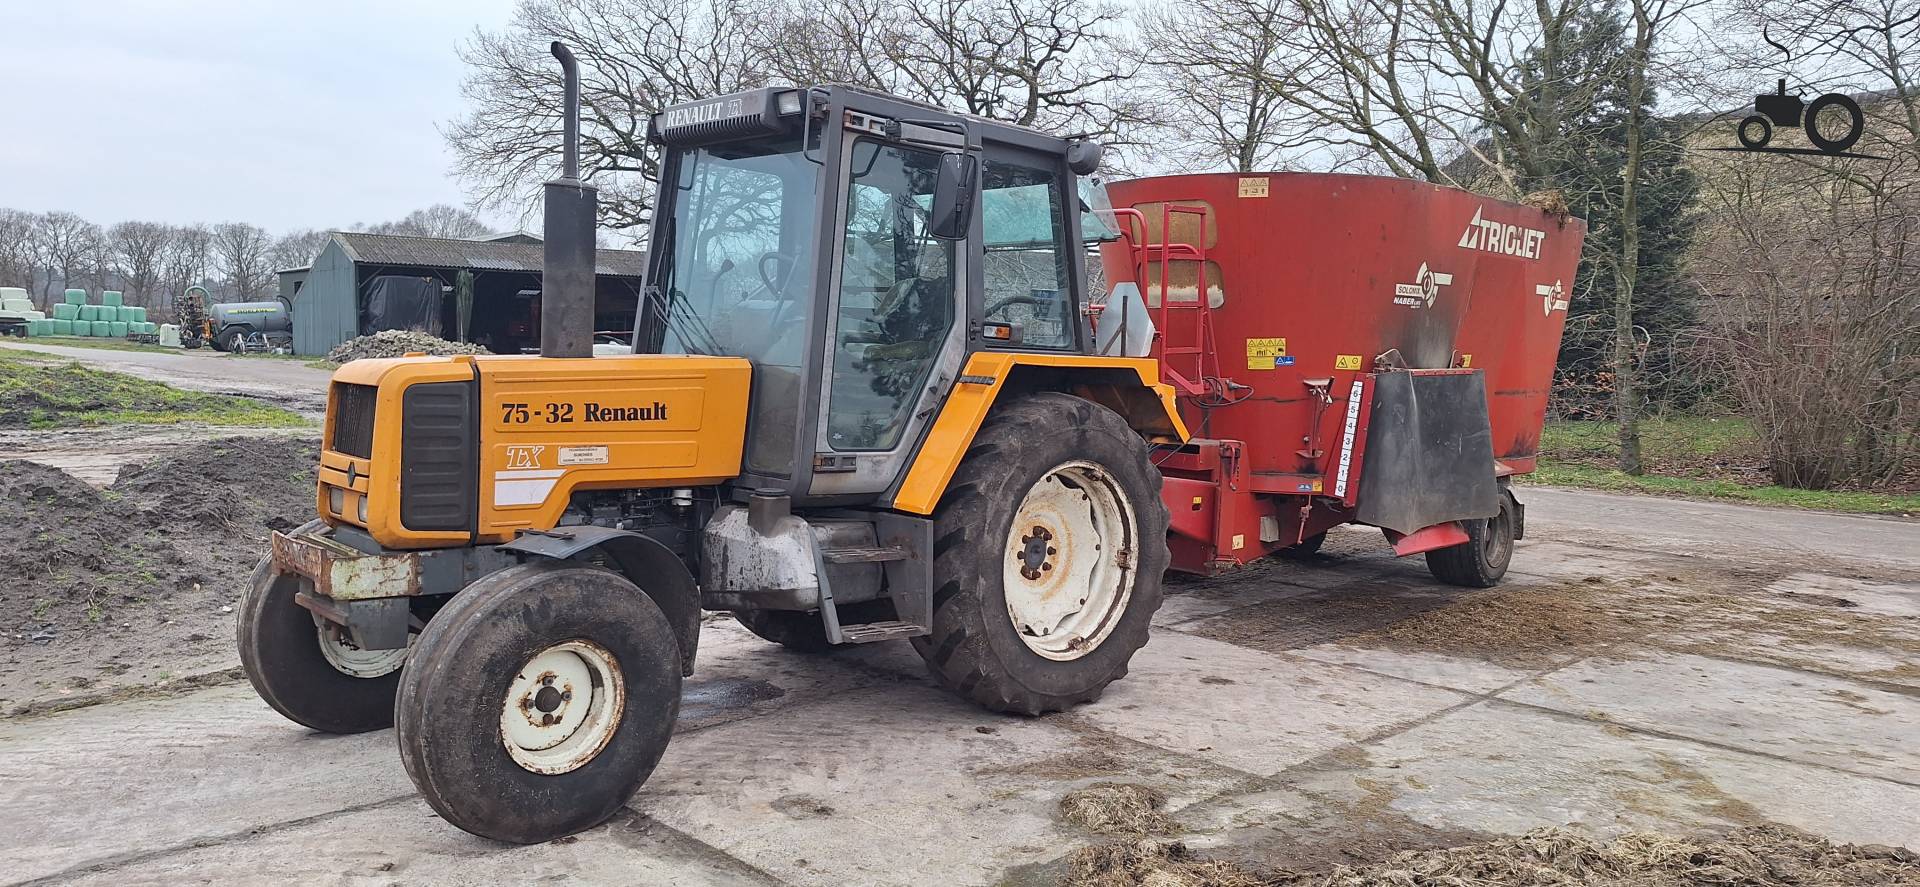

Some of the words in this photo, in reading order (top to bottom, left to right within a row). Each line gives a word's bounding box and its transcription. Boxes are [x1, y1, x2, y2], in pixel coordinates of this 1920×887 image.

[666, 102, 723, 127] RENAULT
[1480, 219, 1545, 260] TRIOLIET
[584, 401, 668, 423] Renault
